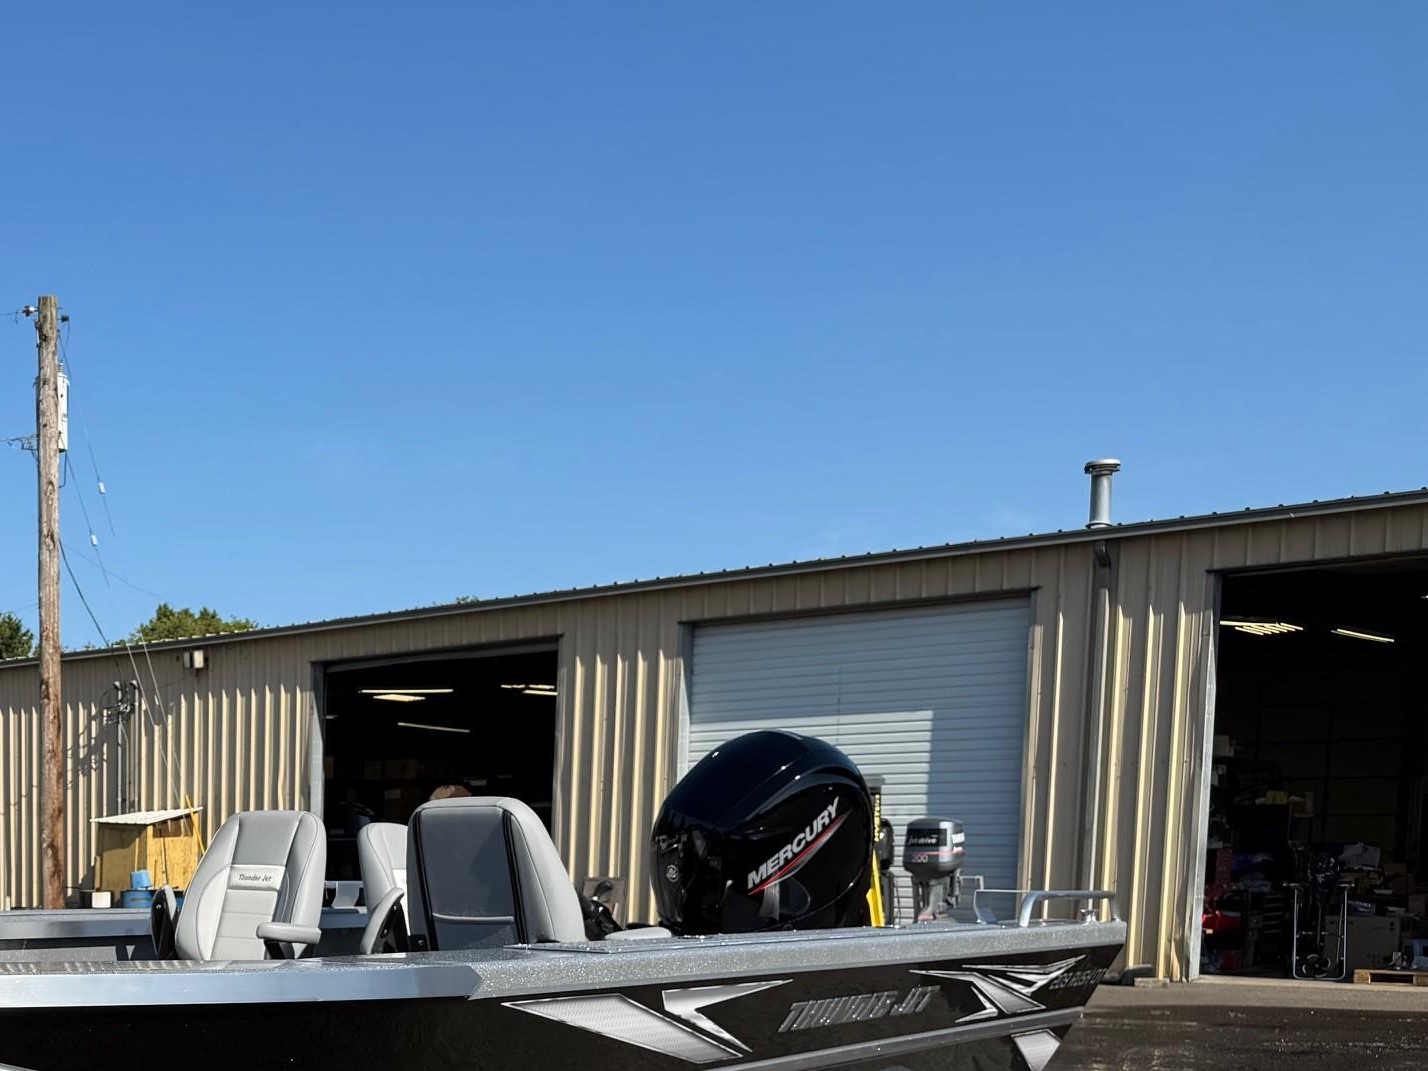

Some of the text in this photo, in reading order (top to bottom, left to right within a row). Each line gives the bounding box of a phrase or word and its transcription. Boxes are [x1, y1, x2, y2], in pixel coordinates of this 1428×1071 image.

[747, 796, 840, 889] MERCURY
[238, 873, 272, 882] Thunder Jet
